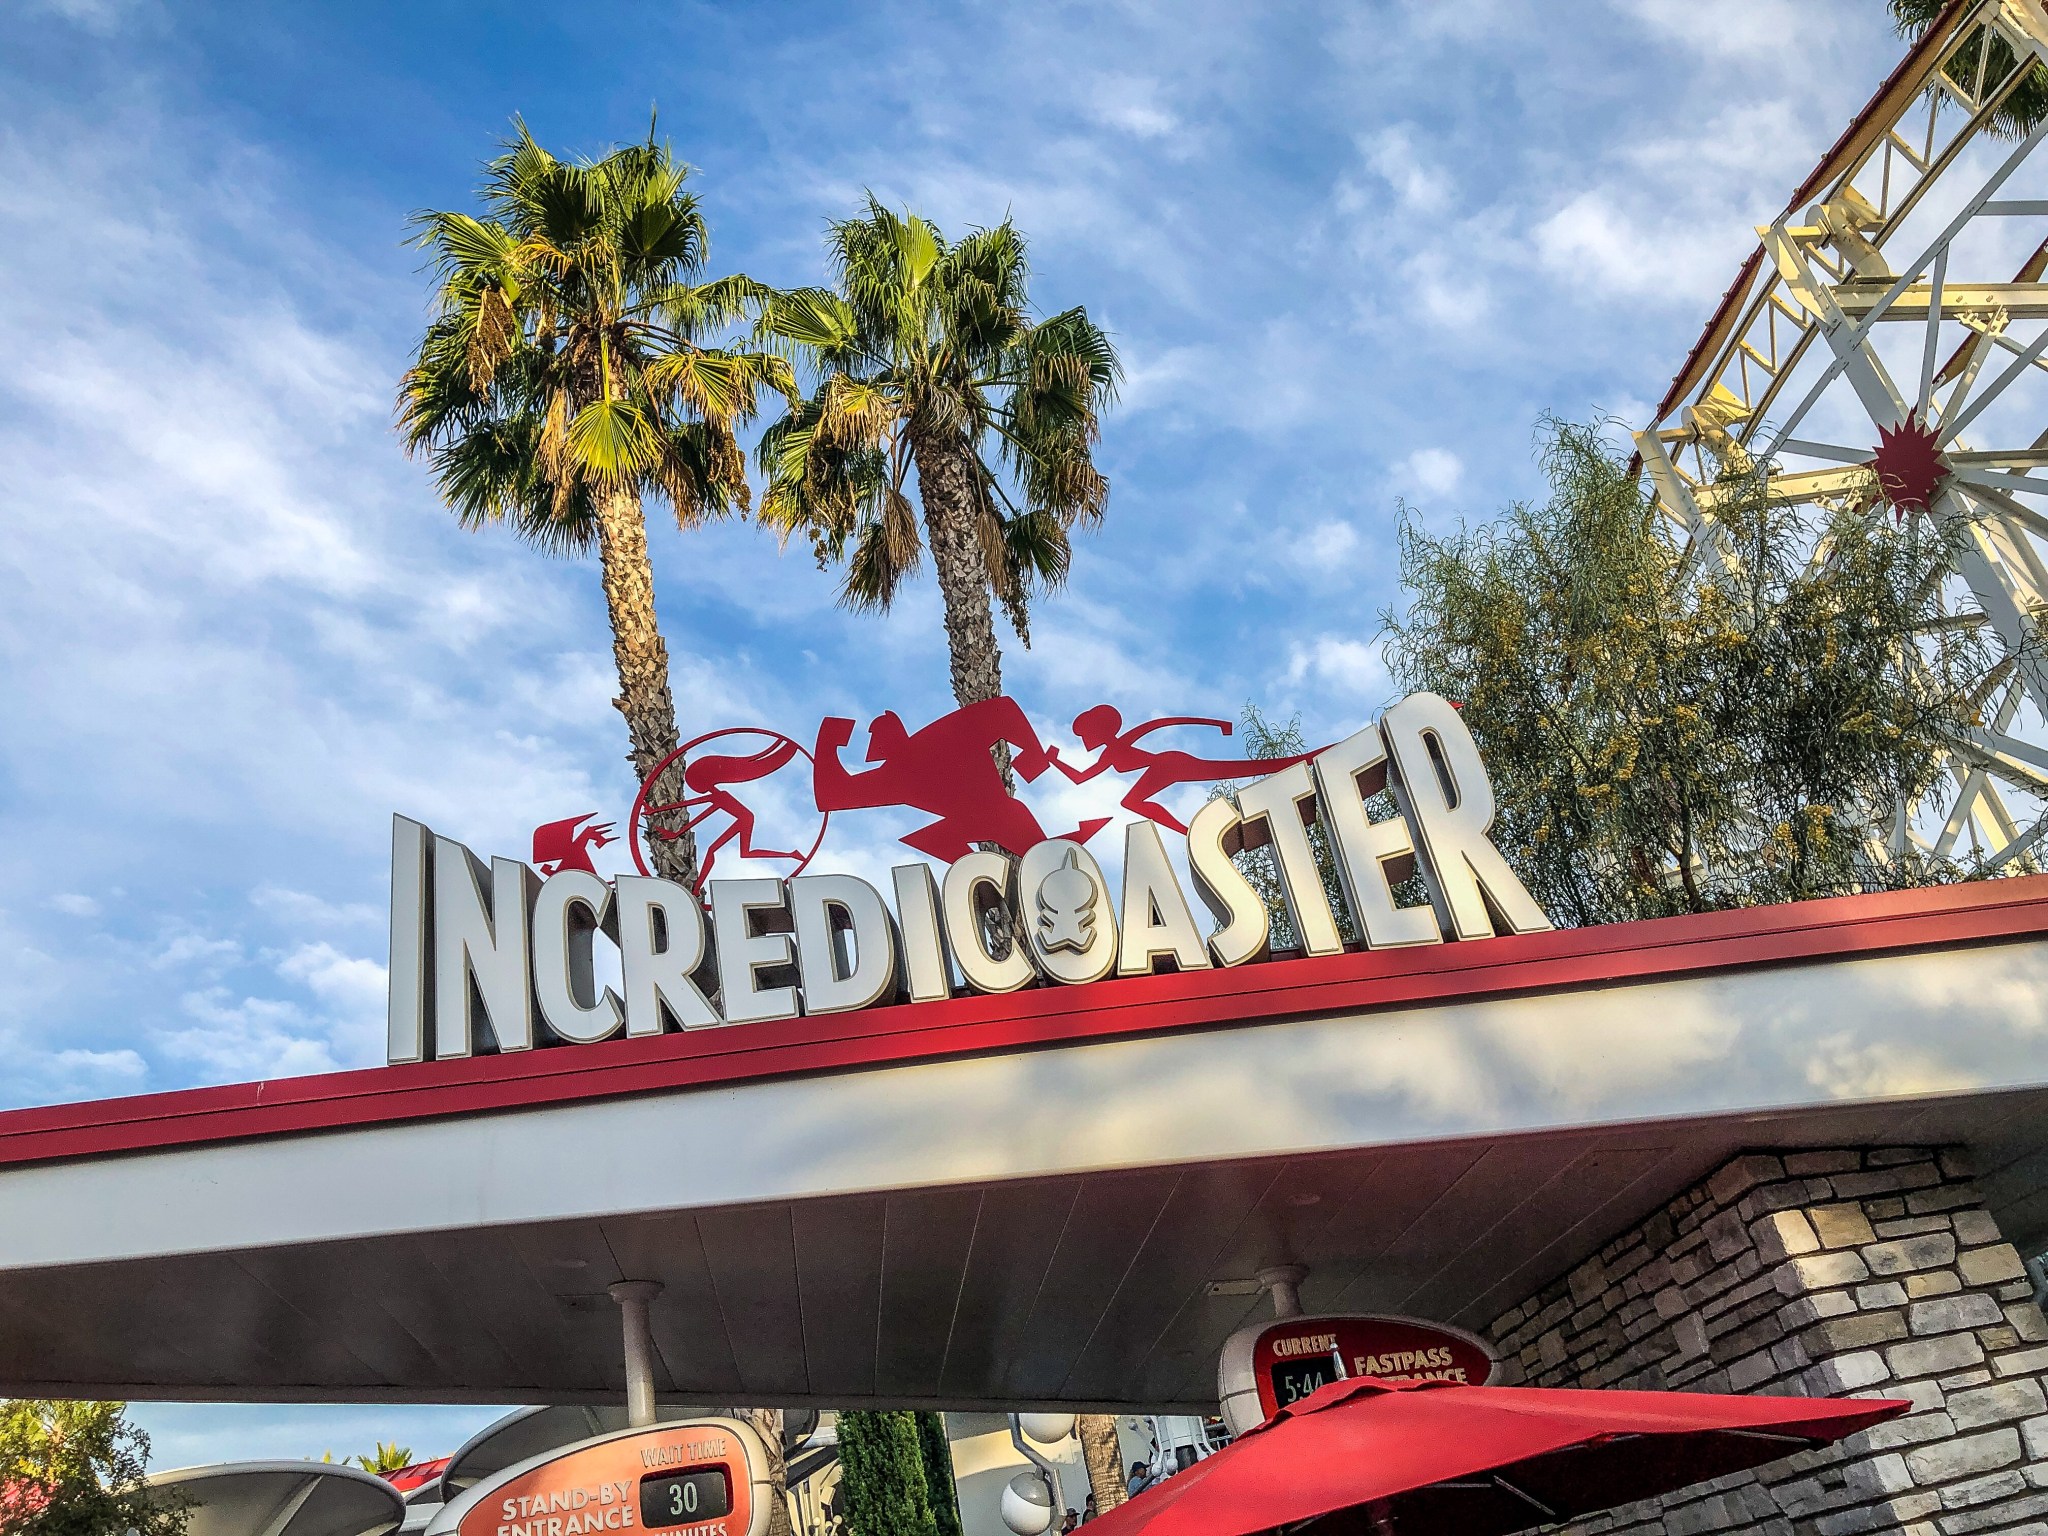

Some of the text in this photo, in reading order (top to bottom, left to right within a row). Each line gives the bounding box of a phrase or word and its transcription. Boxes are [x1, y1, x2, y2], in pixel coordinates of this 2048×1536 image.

[388, 693, 1553, 1065] INCREDICOASTER
[1272, 1333, 1337, 1357] CURRENT
[1353, 1346, 1453, 1376] FASTPASS
[640, 1438, 727, 1469] WAIT TIME
[502, 1480, 633, 1522] STAND-BY
[669, 1482, 698, 1515] 30
[654, 1522, 728, 1536] UTES
